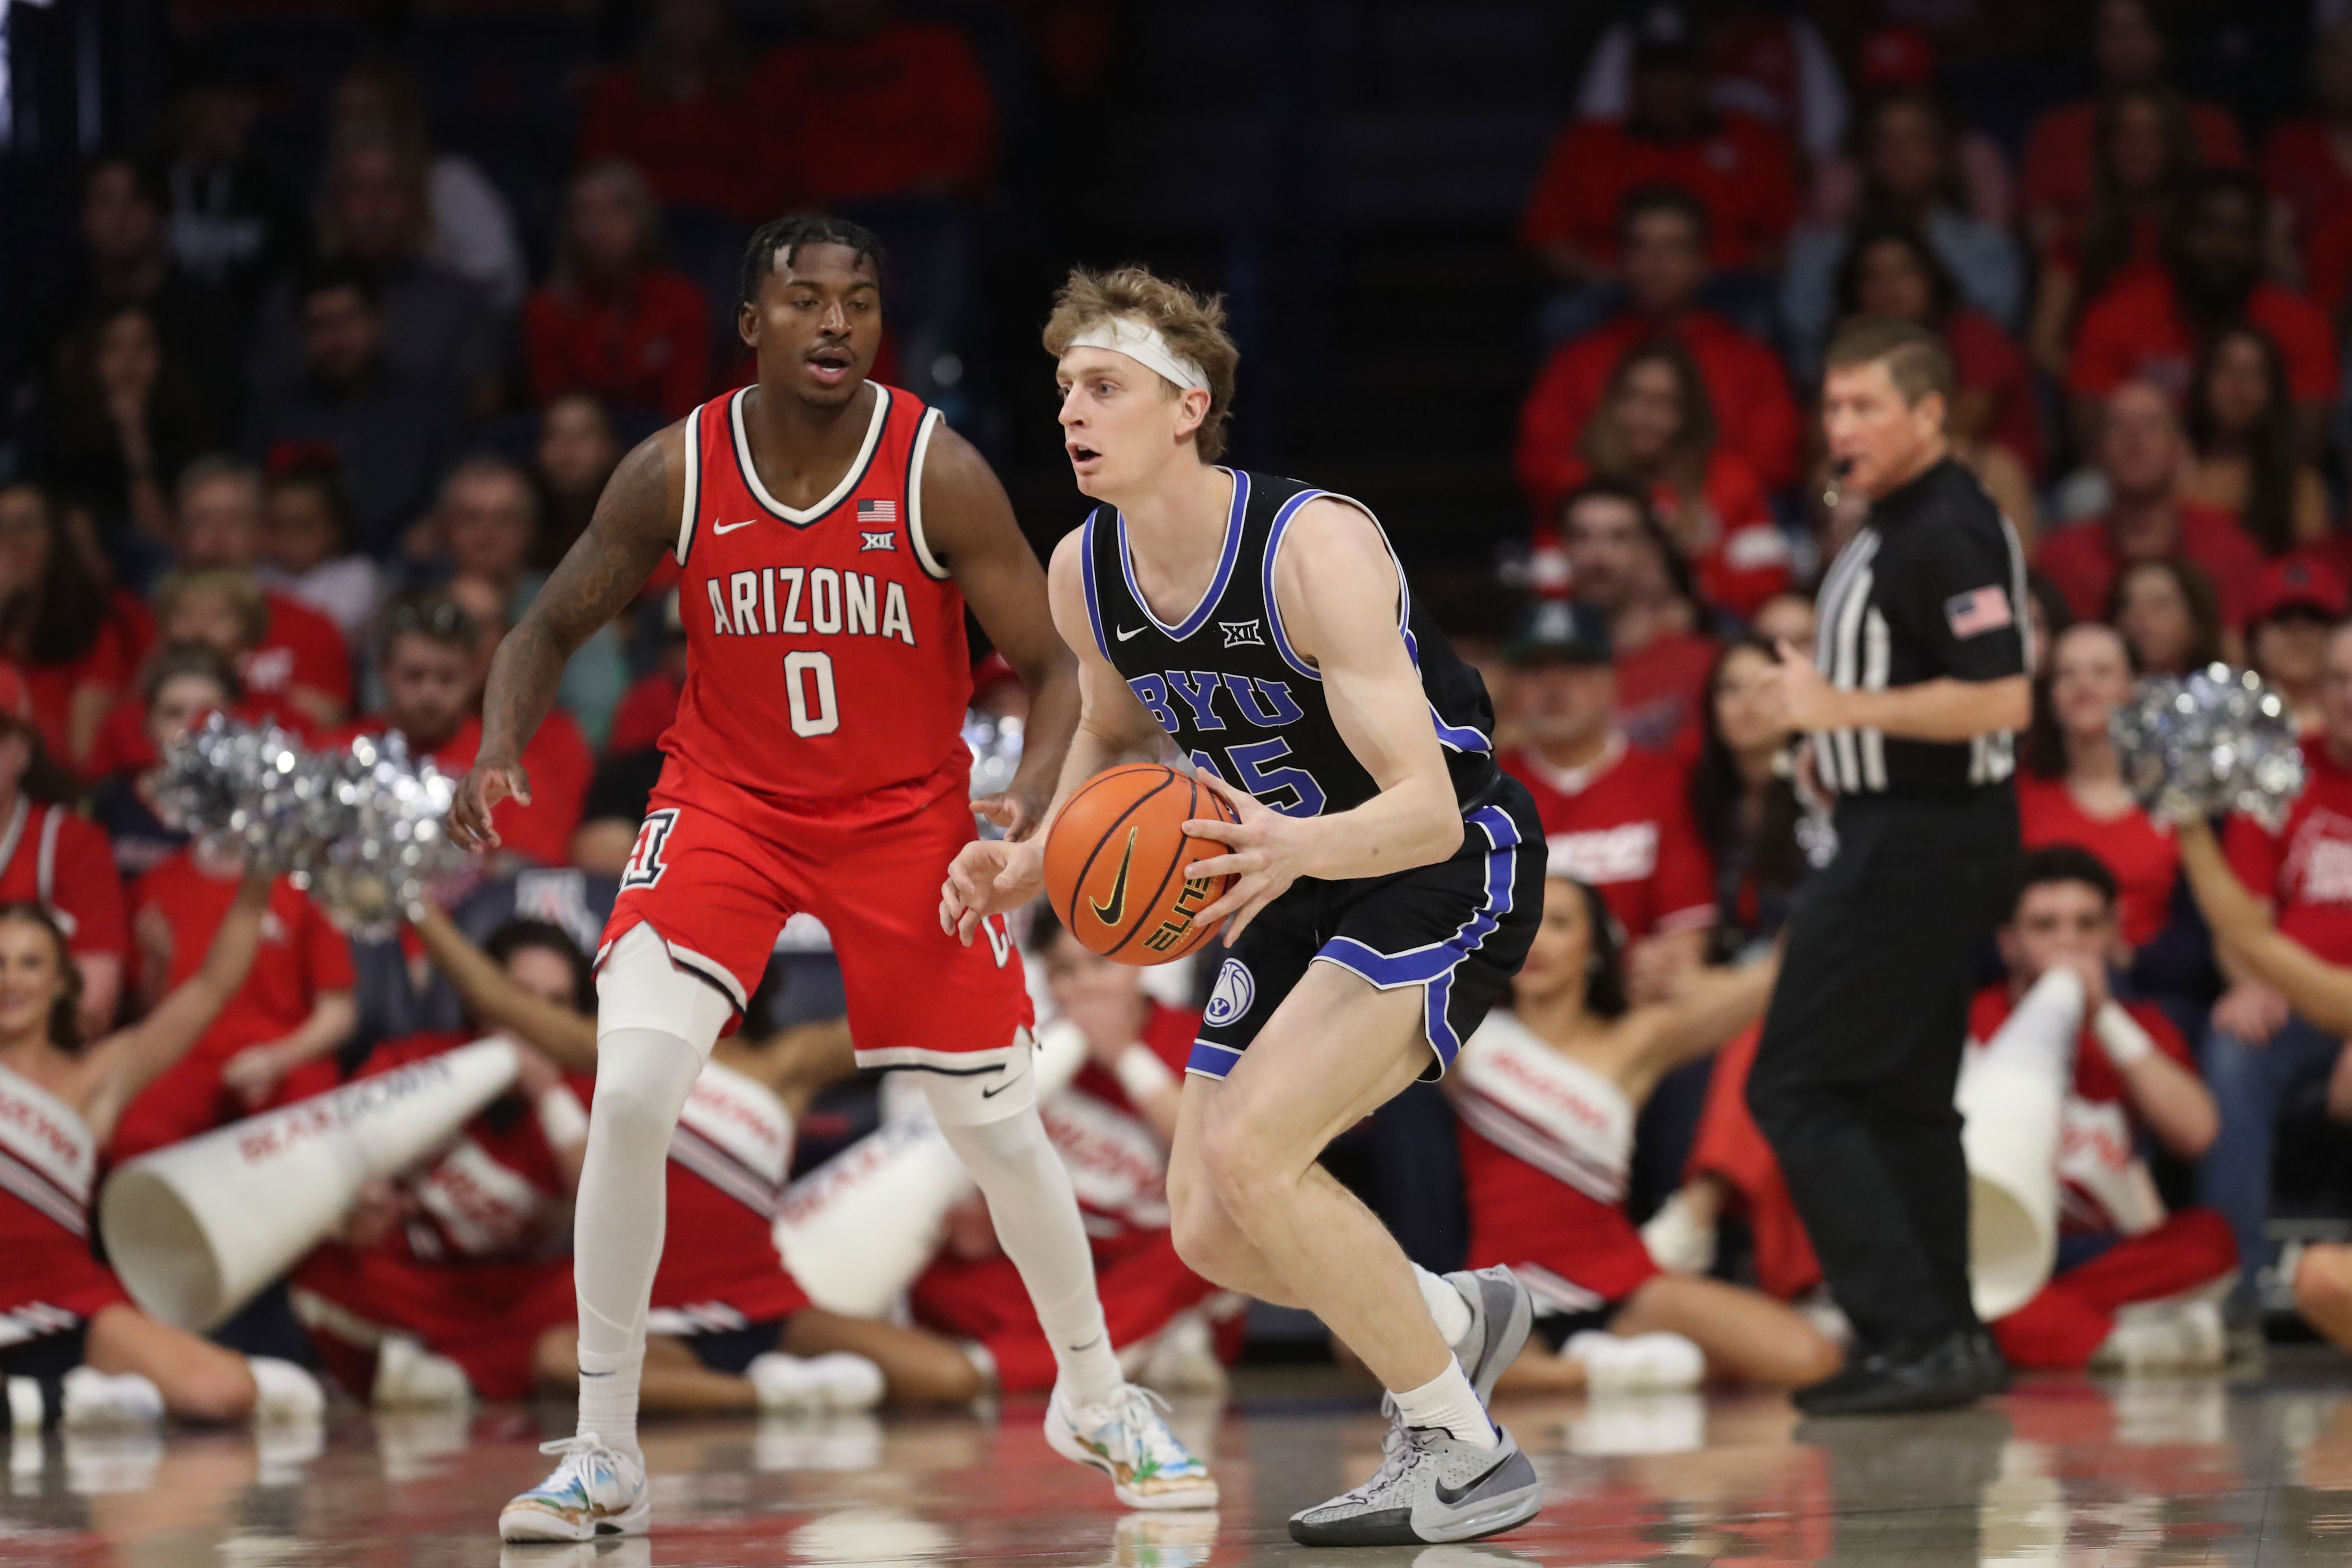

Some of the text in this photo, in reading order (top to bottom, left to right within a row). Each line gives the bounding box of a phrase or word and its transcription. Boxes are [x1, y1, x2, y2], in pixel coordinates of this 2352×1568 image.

[706, 566, 918, 648] ARIZONA
[1218, 618, 1266, 649] XII
[783, 650, 840, 739] 0
[1126, 669, 1305, 734] BYU
